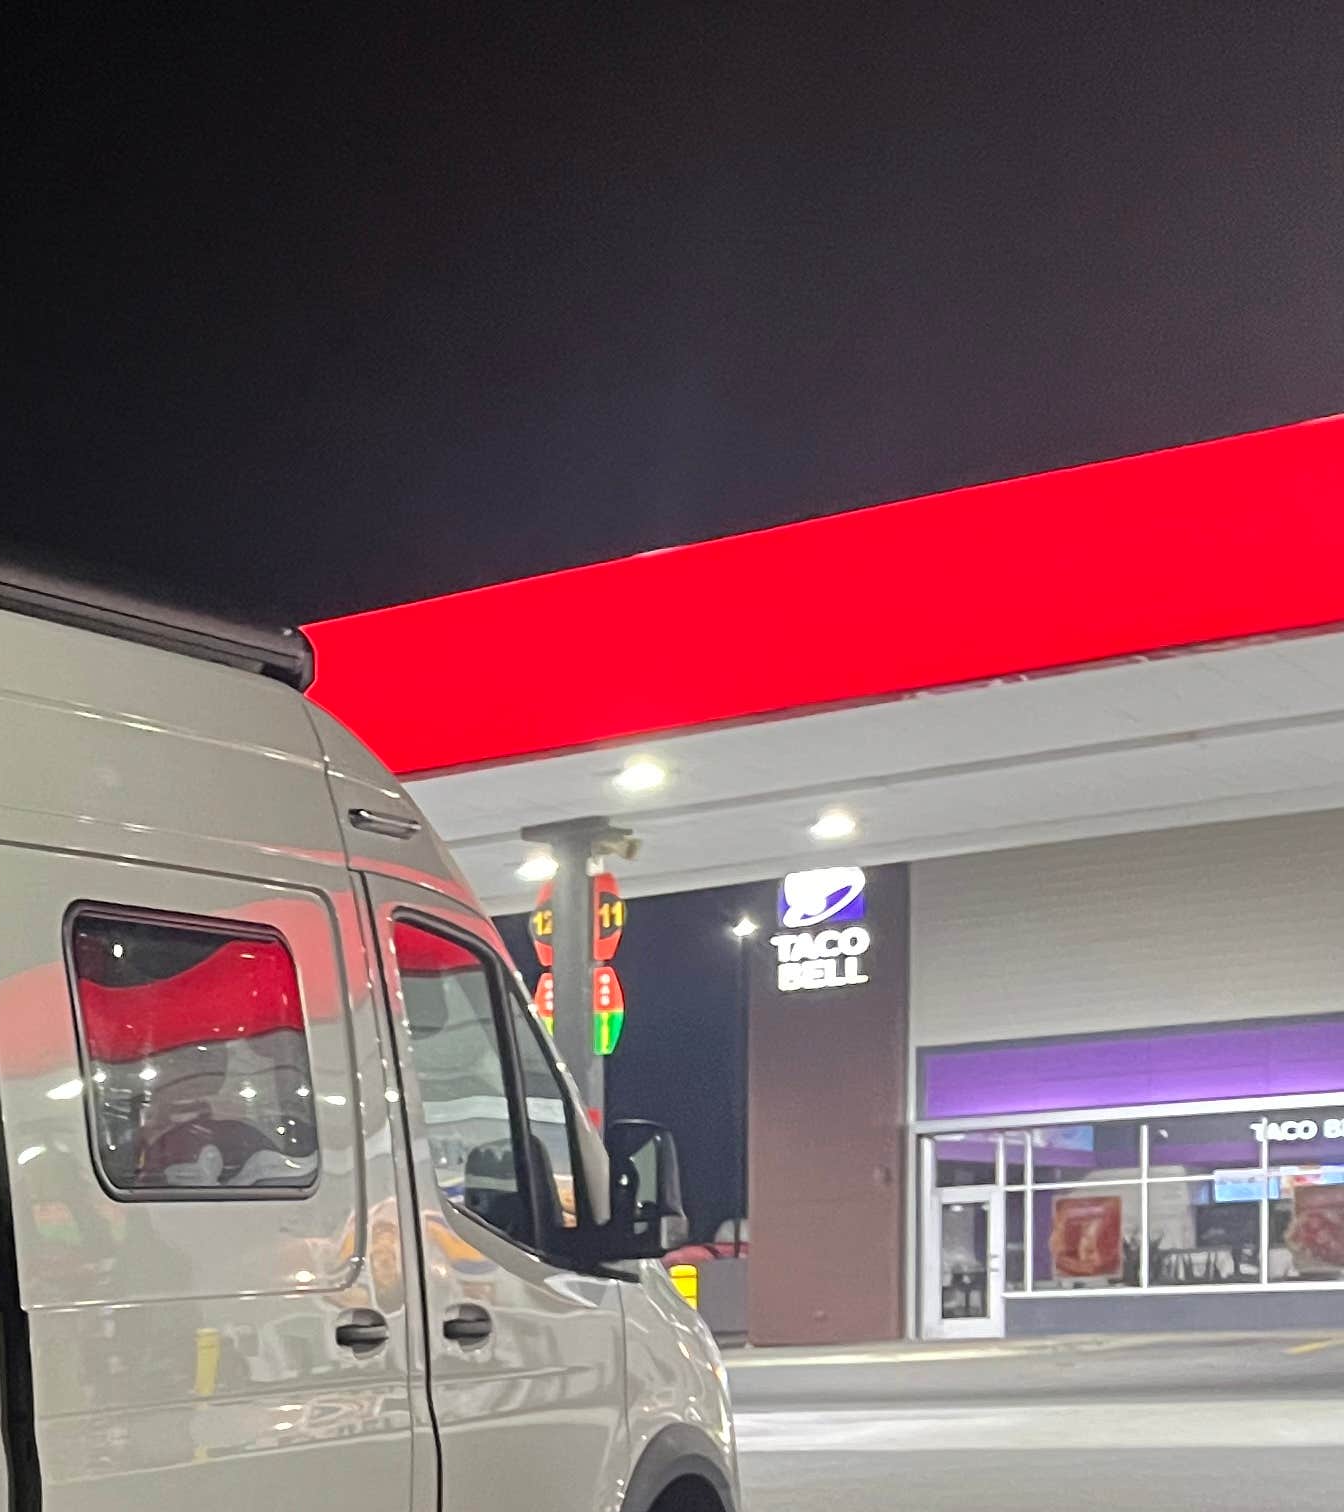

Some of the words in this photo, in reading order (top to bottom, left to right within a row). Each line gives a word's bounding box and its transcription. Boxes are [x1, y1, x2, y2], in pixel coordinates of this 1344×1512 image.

[600, 901, 624, 928] 11
[770, 927, 871, 963] TACO
[778, 957, 869, 991] BELL
[1250, 1119, 1318, 1142] TACO
